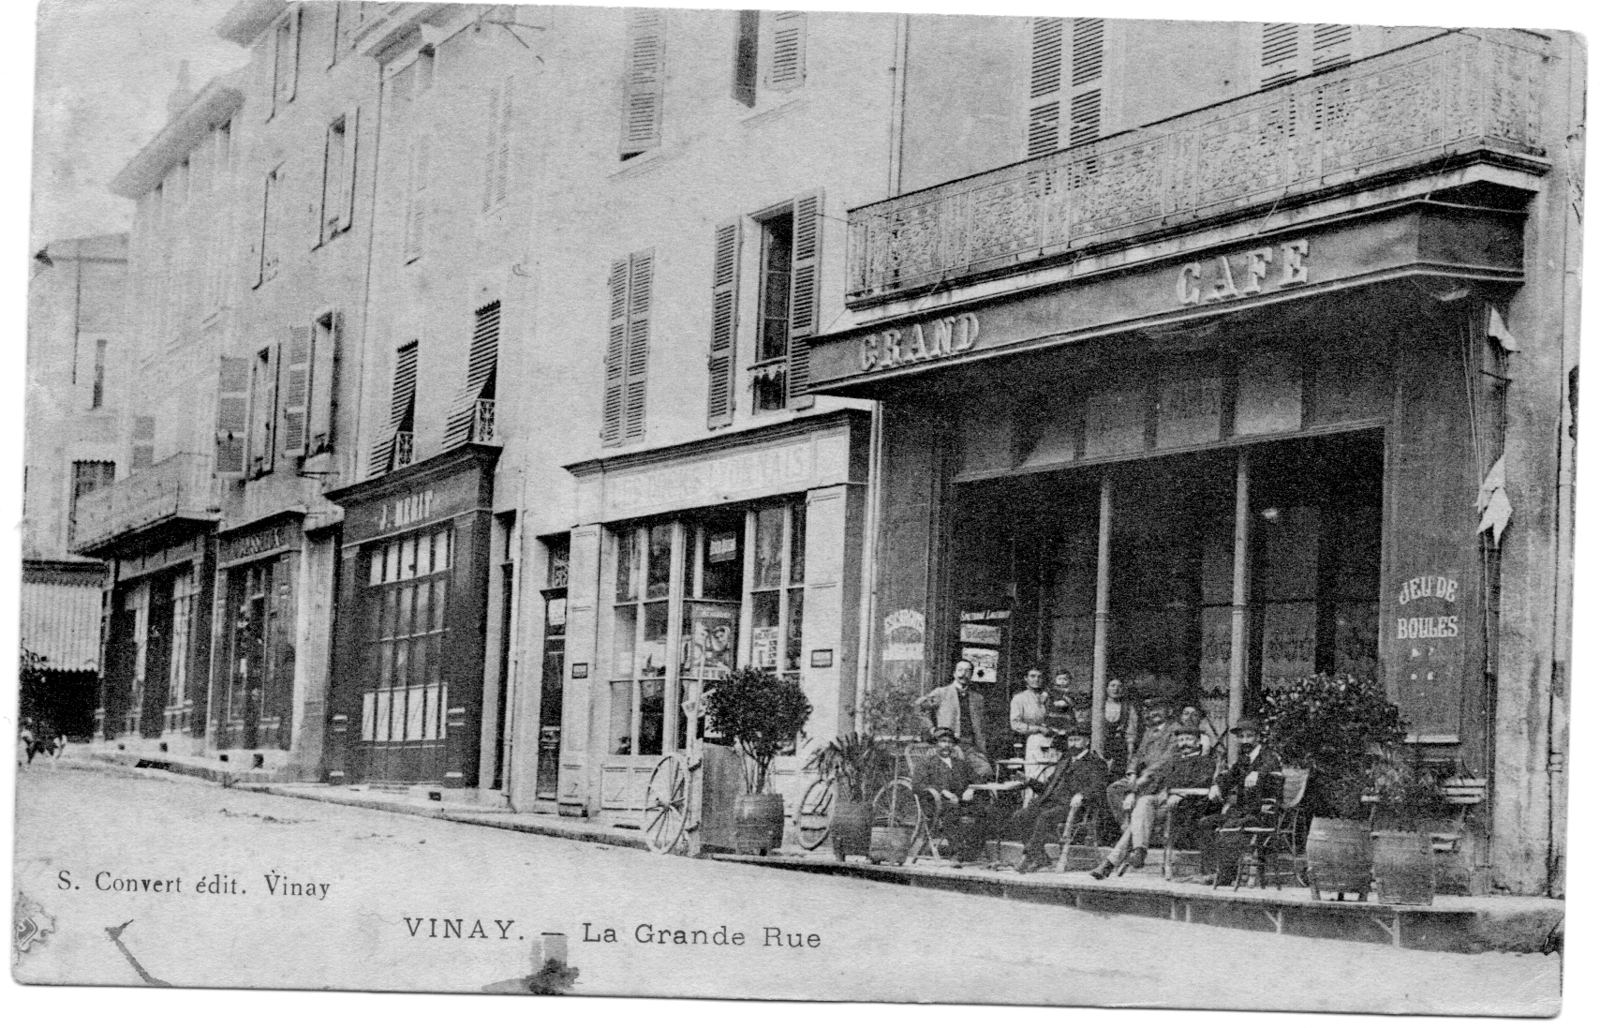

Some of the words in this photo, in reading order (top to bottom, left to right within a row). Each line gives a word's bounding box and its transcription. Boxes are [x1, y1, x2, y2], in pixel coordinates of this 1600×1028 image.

[859, 312, 980, 372] GRAND
[1399, 575, 1432, 605] JEU
[1436, 576, 1458, 602] DE
[1397, 615, 1458, 639] BOULES
